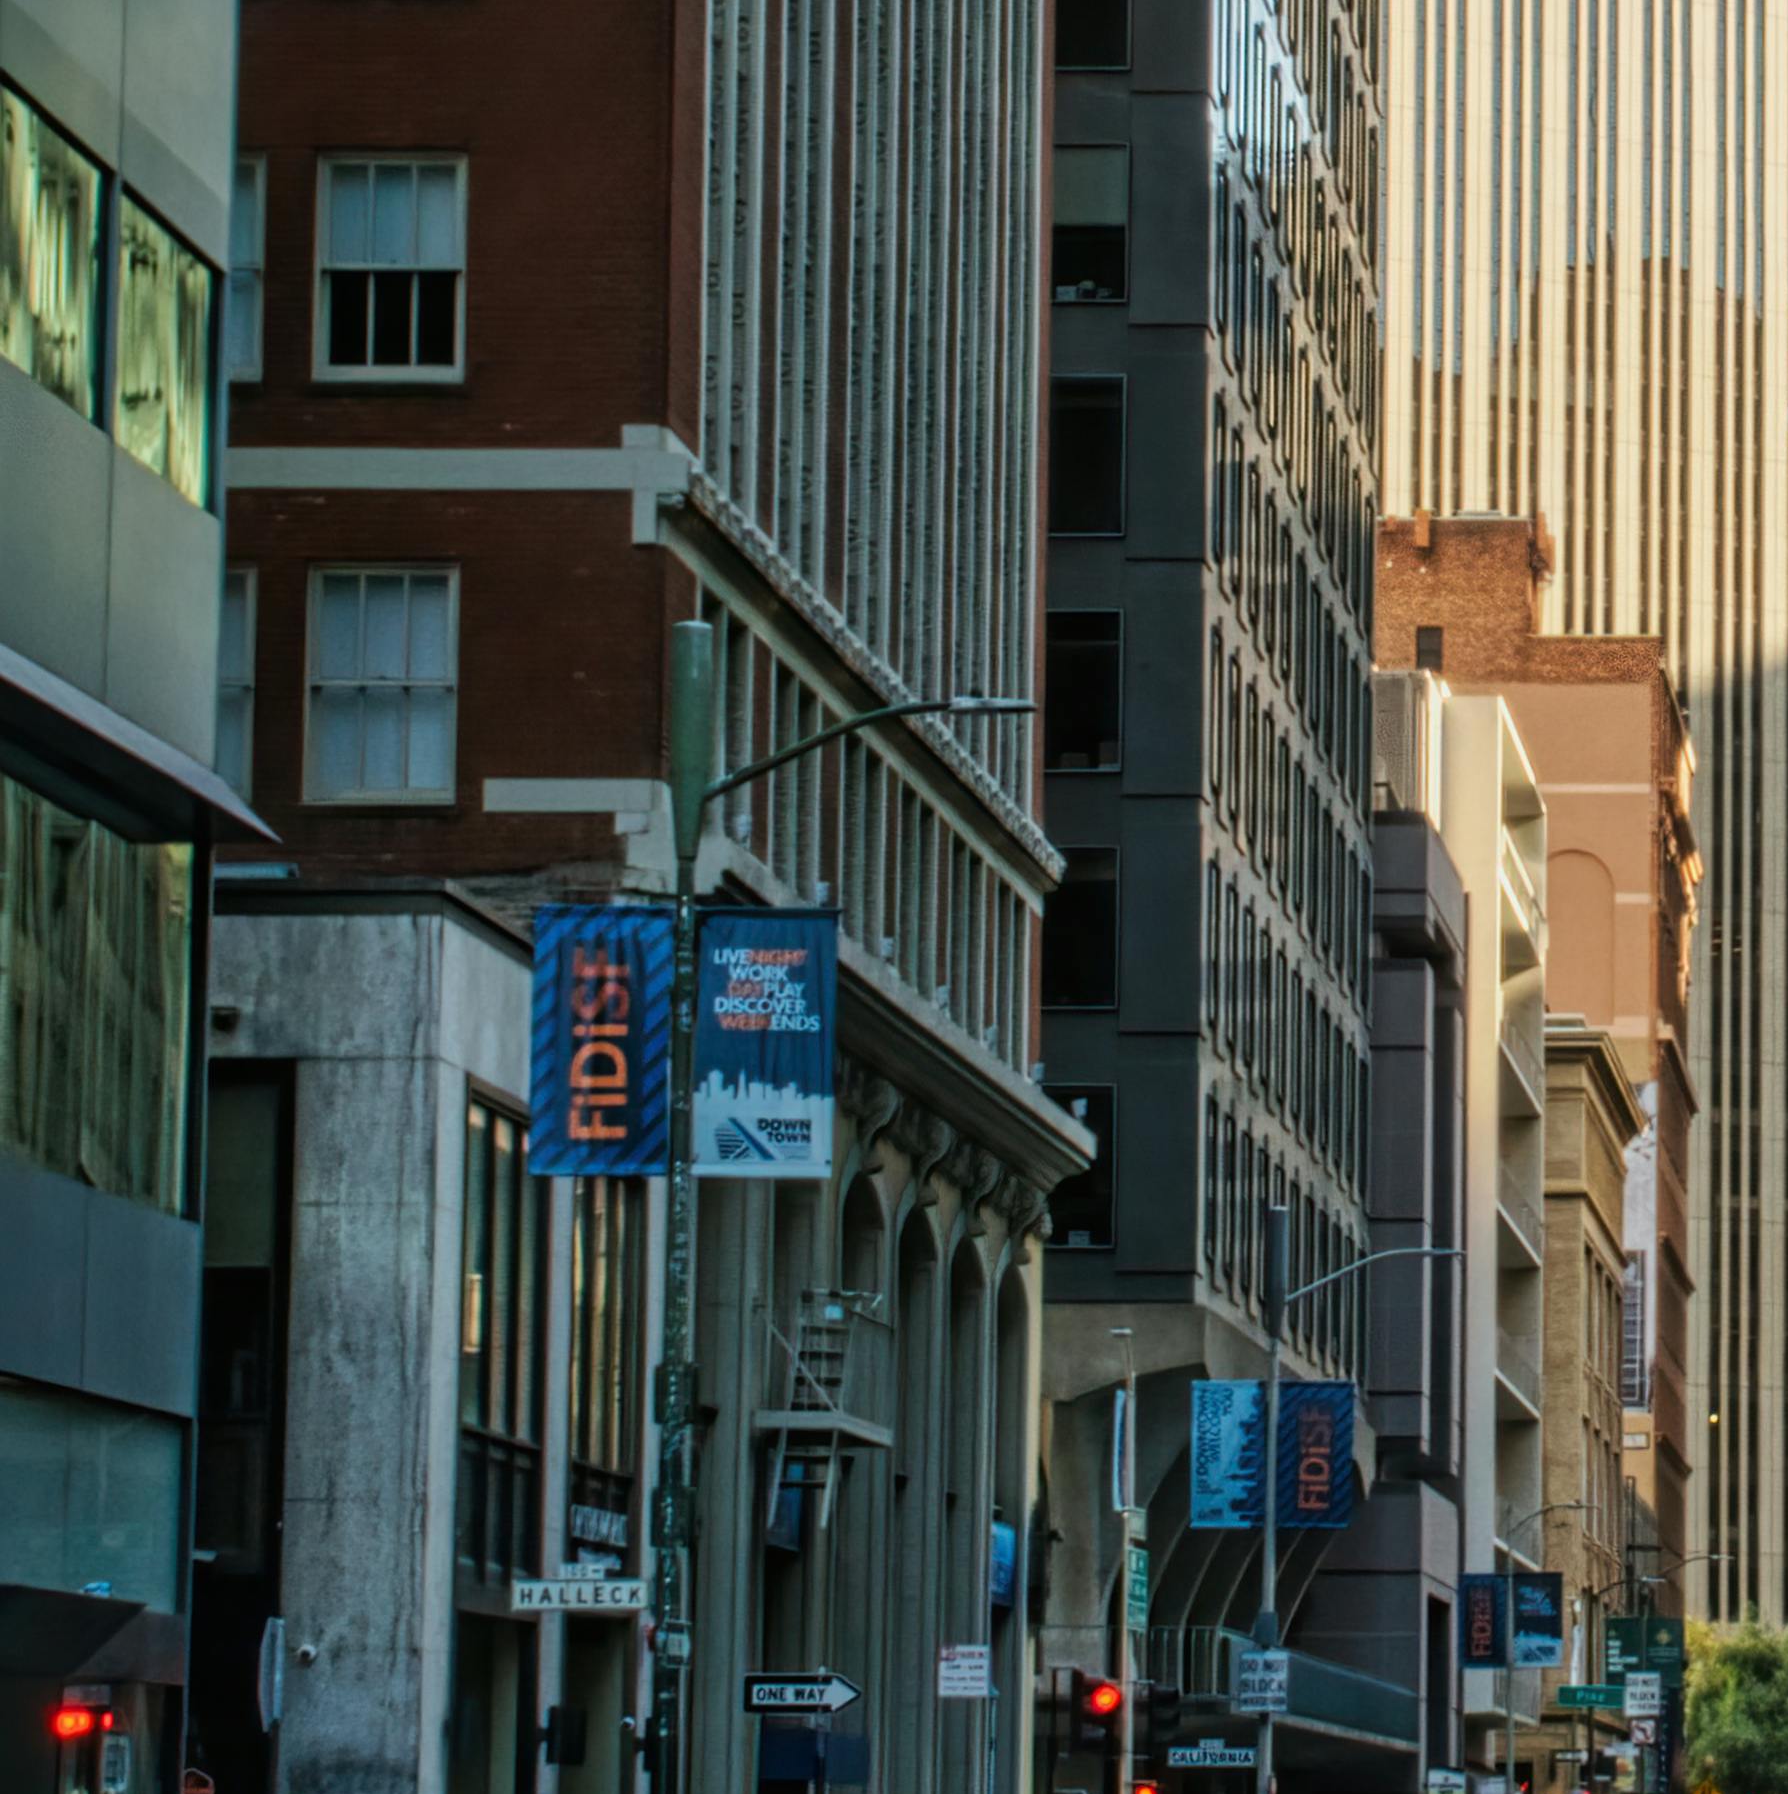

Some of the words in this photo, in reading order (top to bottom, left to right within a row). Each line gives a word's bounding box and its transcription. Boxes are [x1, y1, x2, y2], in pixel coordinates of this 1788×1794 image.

[729, 965, 788, 981] WORK
[714, 996, 806, 1013] DISCOVER
[756, 1118, 811, 1131] DOWN
[766, 1132, 811, 1143] TOWN
[520, 1587, 641, 1605] HALLECK
[756, 1687, 787, 1701] ONE
[794, 1687, 826, 1701] WAY
[1171, 1750, 1253, 1763] CALIFORNIA
